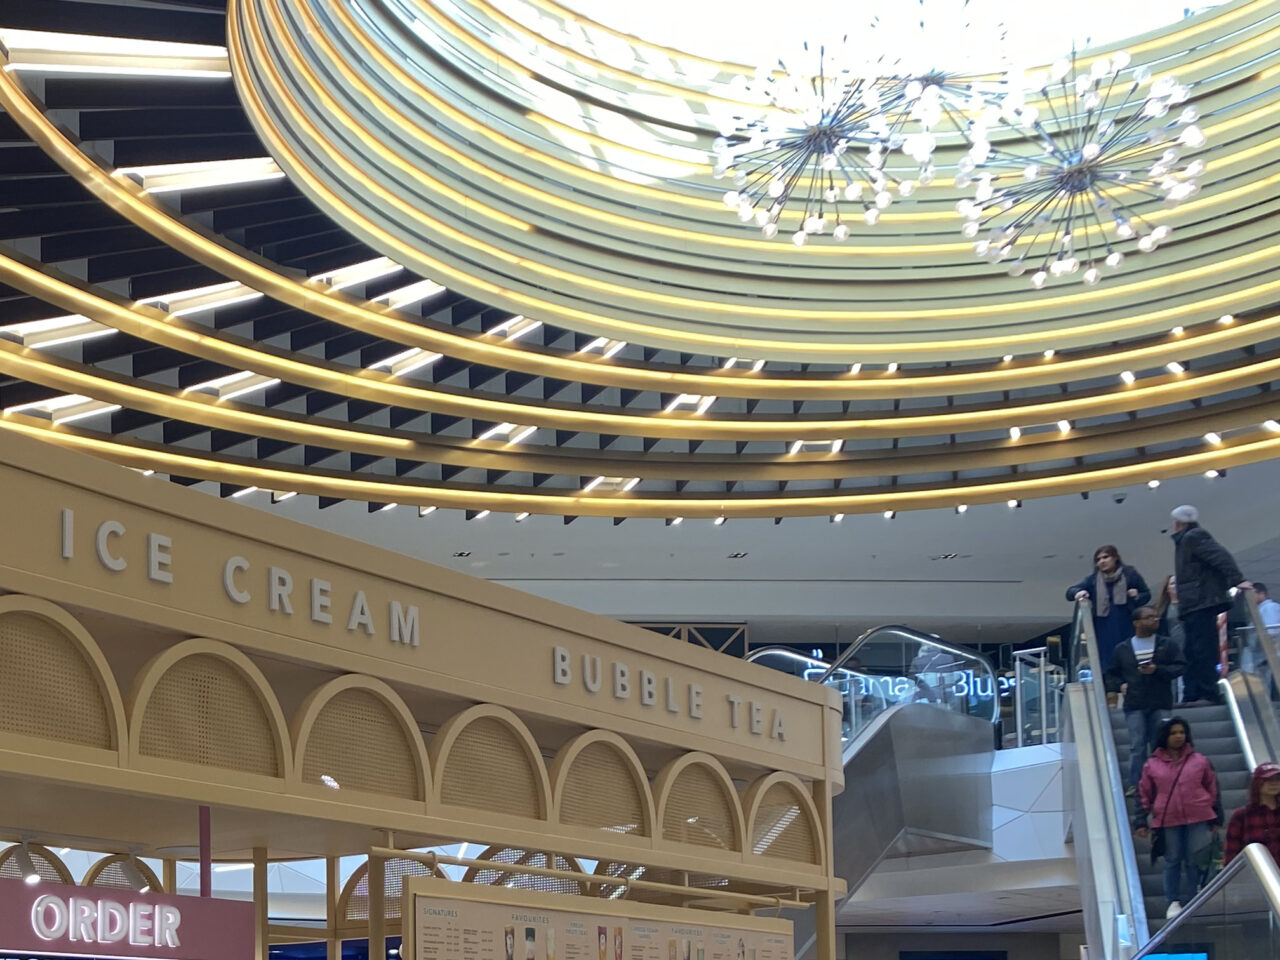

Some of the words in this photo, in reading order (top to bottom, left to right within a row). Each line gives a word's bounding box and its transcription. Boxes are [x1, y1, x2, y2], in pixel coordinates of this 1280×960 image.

[61, 508, 174, 584] ICE
[222, 555, 421, 648] CREAM
[553, 646, 704, 720] BUBBLE
[726, 694, 787, 742] TEA
[31, 893, 182, 949] ORDER
[423, 907, 458, 918] SIGNATURES
